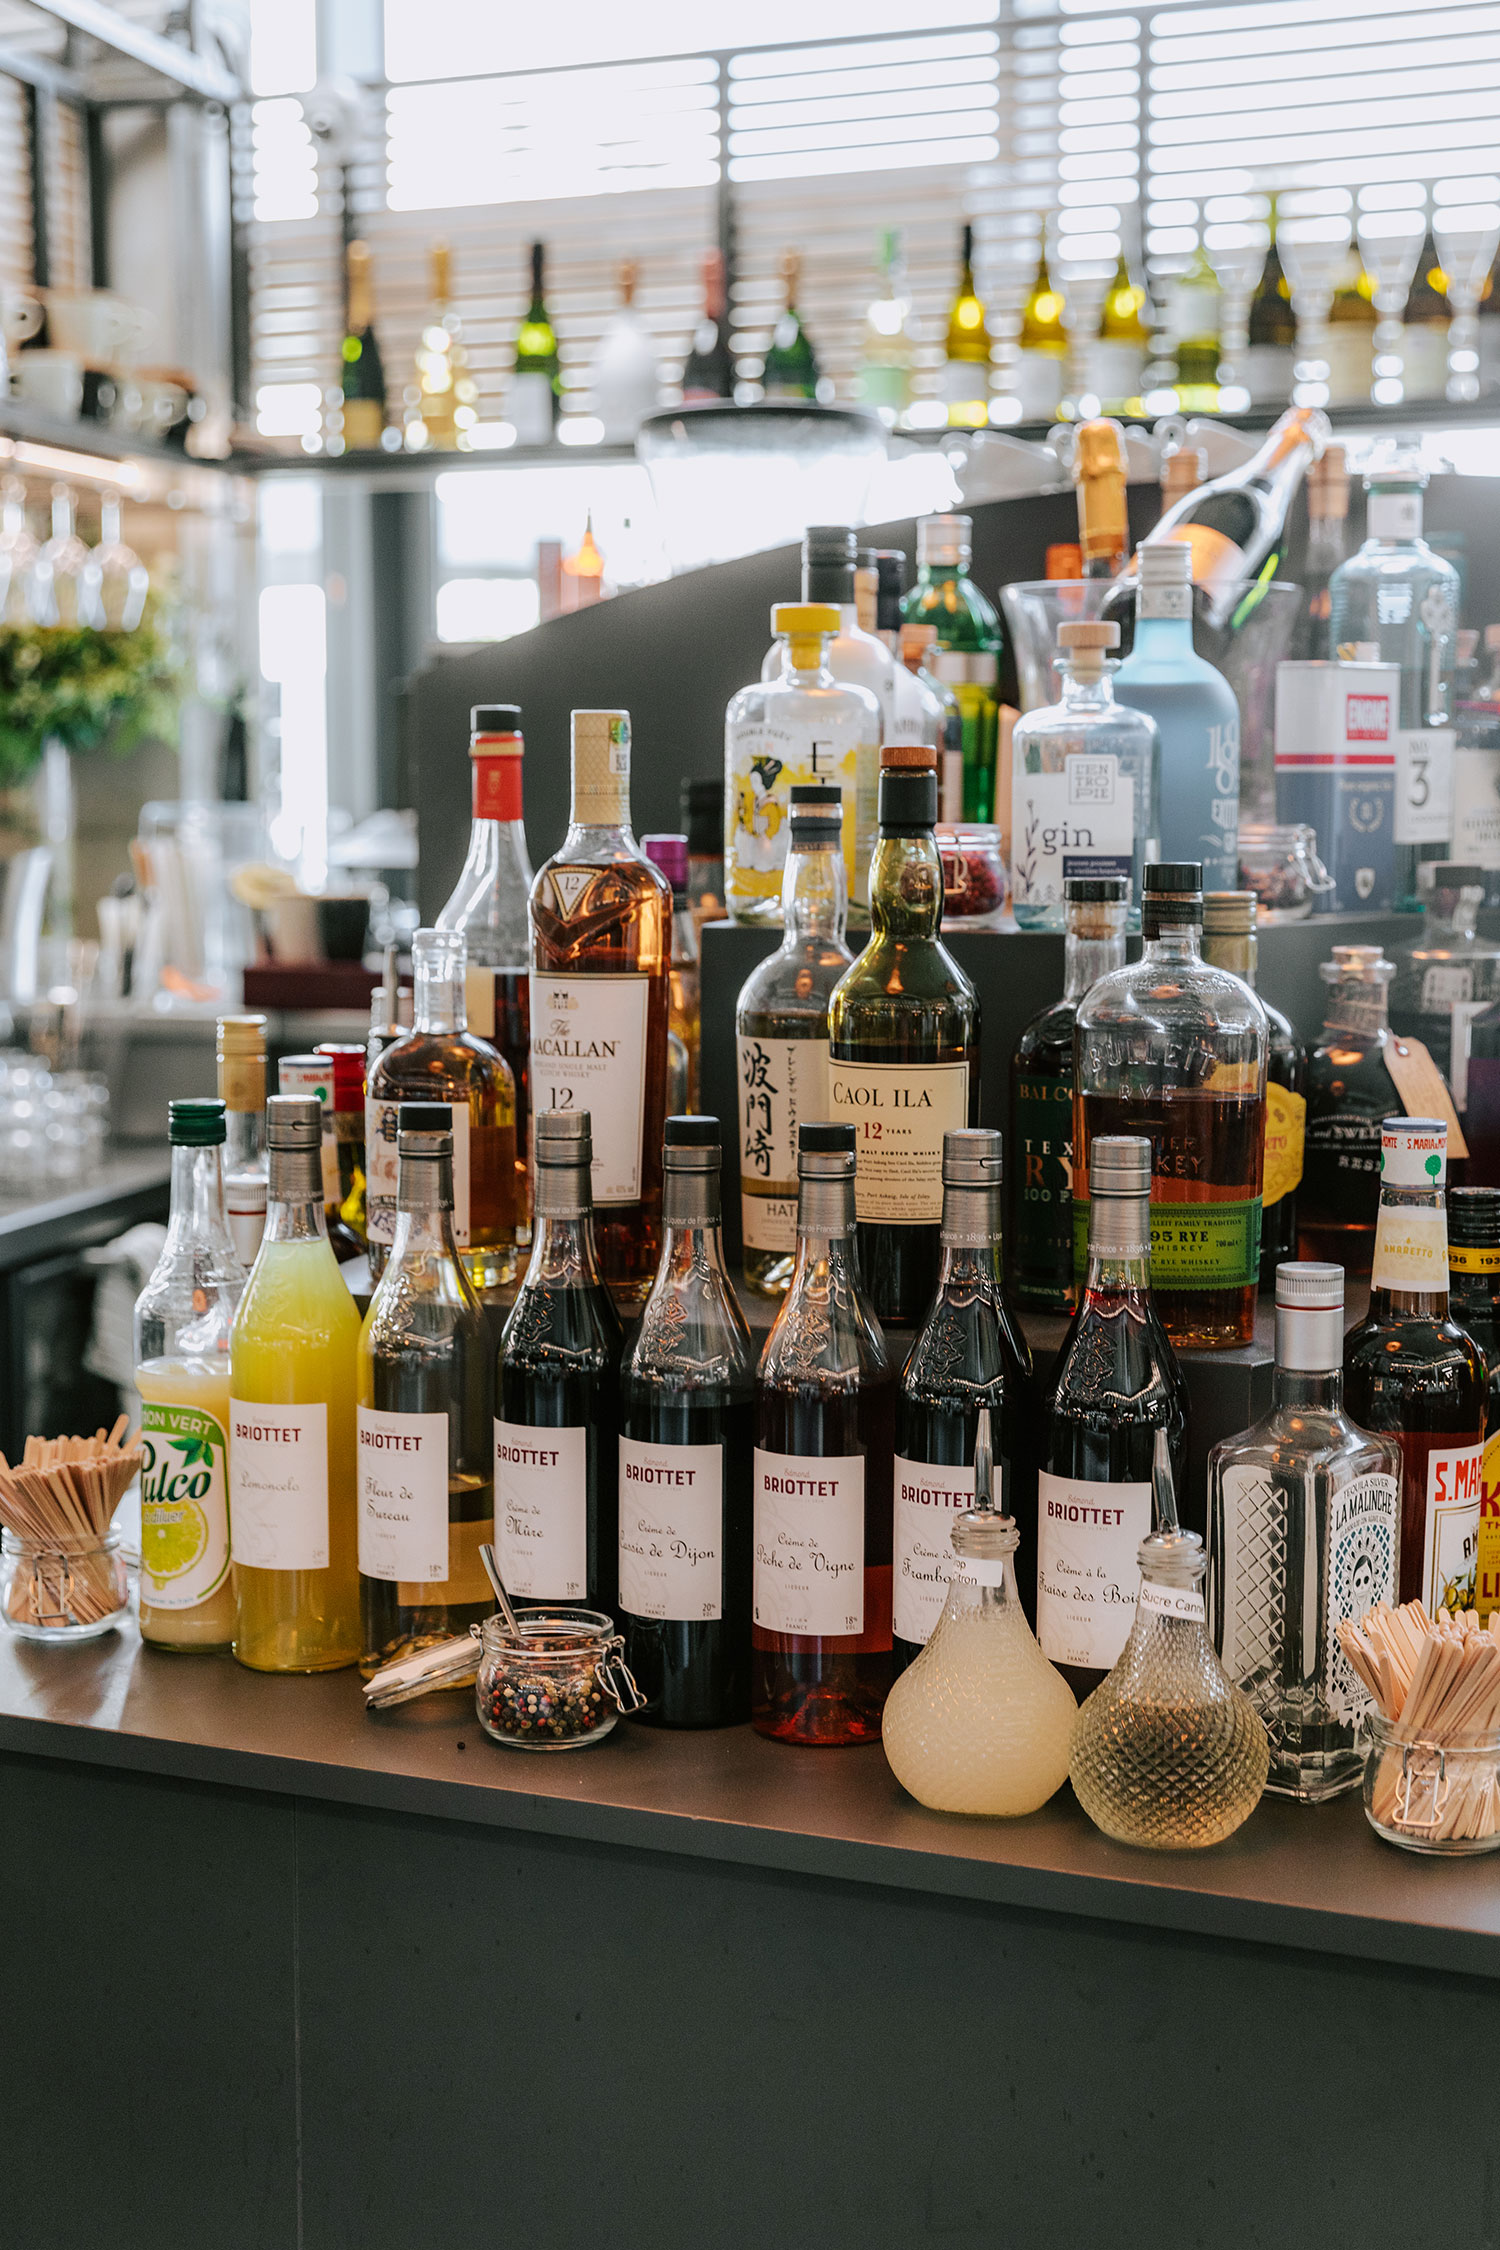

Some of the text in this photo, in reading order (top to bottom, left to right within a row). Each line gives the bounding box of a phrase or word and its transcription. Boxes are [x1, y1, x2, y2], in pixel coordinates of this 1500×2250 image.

[1075, 776, 1109, 786] TRO
[1409, 760, 1430, 806] 3
[1075, 788, 1109, 799] PIE
[1042, 822, 1094, 855] gin
[564, 876, 579, 890] 12
[549, 1019, 571, 1038] The
[1090, 1039, 1217, 1076] BULLEIT
[550, 1087, 574, 1110] 12
[833, 1082, 932, 1107] CAOL ILA
[1119, 1083, 1178, 1102] RYE
[864, 1122, 882, 1140] 12
[1024, 1187, 1051, 1202] 100
[1175, 1219, 1200, 1227] FAMILY
[1204, 1219, 1242, 1227] TRADITION
[1150, 1231, 1209, 1242] 95 RYE
[1385, 1245, 1432, 1258] AMARETTO
[169, 1413, 213, 1435] VERT
[235, 1423, 302, 1443] BRIOTTET
[360, 1430, 422, 1451] BRIOTTET
[497, 1443, 559, 1466] BRIOTTET
[626, 1463, 696, 1485] BRIOTTET
[365, 1477, 414, 1500] Fleur de
[764, 1475, 839, 1496] BRIOTTET
[1344, 1477, 1389, 1499] TEQUILA SILVER
[902, 1484, 974, 1508] BRIOTTET
[150, 1508, 185, 1524] diluer
[366, 1499, 410, 1522] Sureau
[506, 1499, 541, 1515] Crème de
[1047, 1501, 1124, 1525] BRIOTTET
[1336, 1503, 1347, 1532] LA
[1349, 1489, 1392, 1519] MALINCHE
[505, 1515, 544, 1538] Mûre
[638, 1519, 676, 1535] Crème de
[777, 1532, 818, 1548] Crème de
[649, 1543, 663, 1558] de
[670, 1540, 715, 1566] Dijon
[756, 1544, 855, 1579] Pêche de Vigne
[913, 1543, 952, 1560] Crème de
[1056, 1559, 1106, 1579] Crème à la
[1039, 1571, 1068, 1598] Fraise
[1073, 1586, 1094, 1602] des
[1142, 1588, 1171, 1607] Sucre
[785, 1623, 808, 1631] FRANCE
[1066, 1614, 1091, 1622] LIQUEUR
[1067, 1655, 1089, 1664] FRANCE
